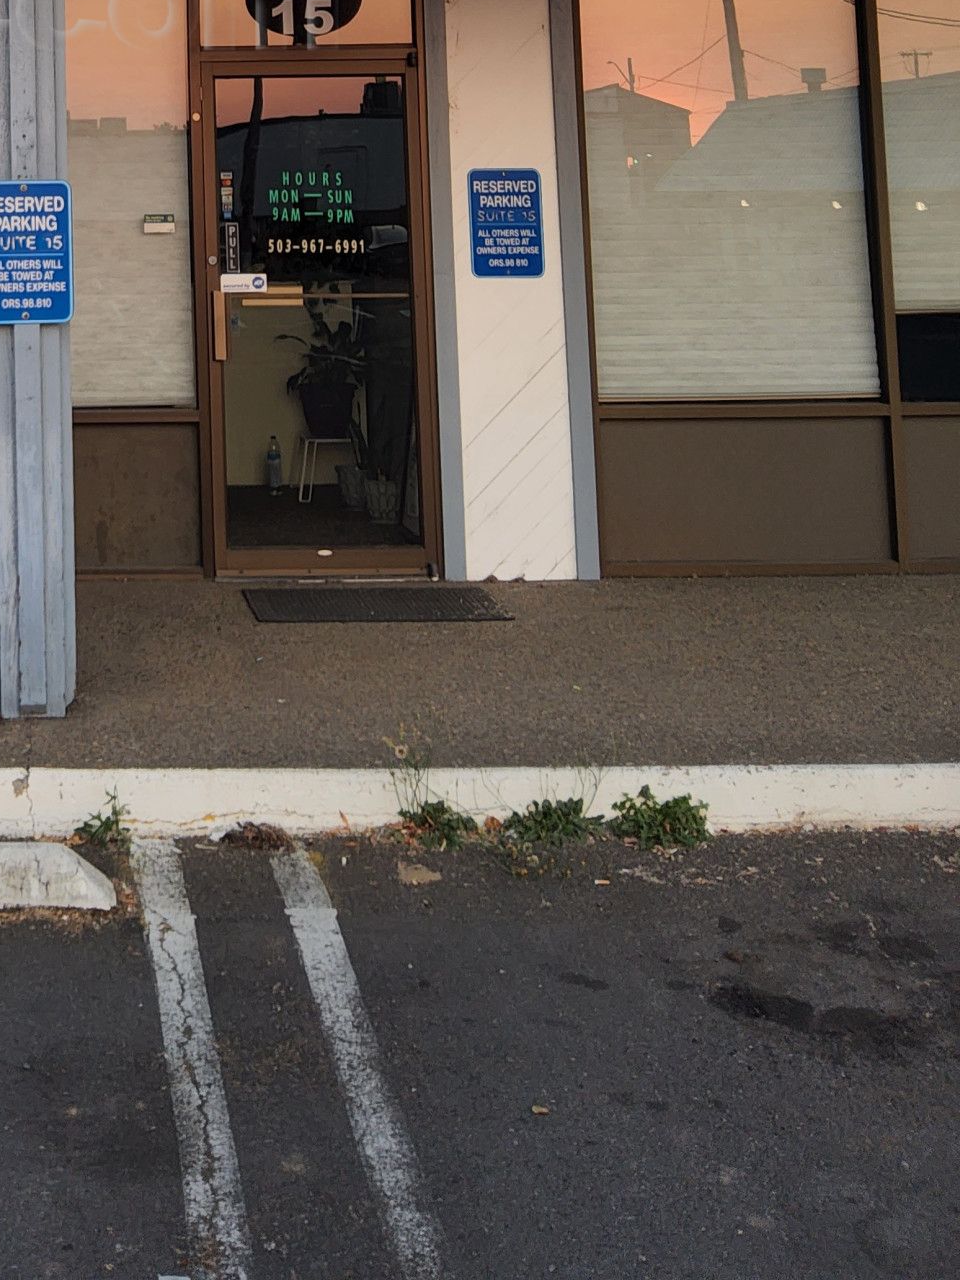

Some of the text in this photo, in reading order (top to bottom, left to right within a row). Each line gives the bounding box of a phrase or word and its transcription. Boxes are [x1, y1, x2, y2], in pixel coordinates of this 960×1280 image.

[282, 171, 343, 186] HOURS
[473, 180, 536, 193] RESERVED
[268, 190, 300, 204] MON
[327, 189, 353, 204] SUN
[480, 195, 532, 208] PARKING
[272, 208, 301, 222] 9AM
[327, 208, 354, 223] 9PM
[478, 210, 515, 222] SUITE
[478, 229, 536, 237] ALL OTHERS WILL
[45, 235, 63, 250] 15
[228, 226, 237, 270] PULL
[268, 238, 365, 254] 503-967-6991
[484, 238, 530, 246] BE TOWED AT
[476, 246, 540, 255] OWNERS EXPENSE
[6, 260, 42, 270] OTHERS
[42, 259, 63, 270] WILL
[12, 271, 42, 282] TOWED
[44, 270, 54, 280] AT
[26, 282, 66, 292] EXPENSE
